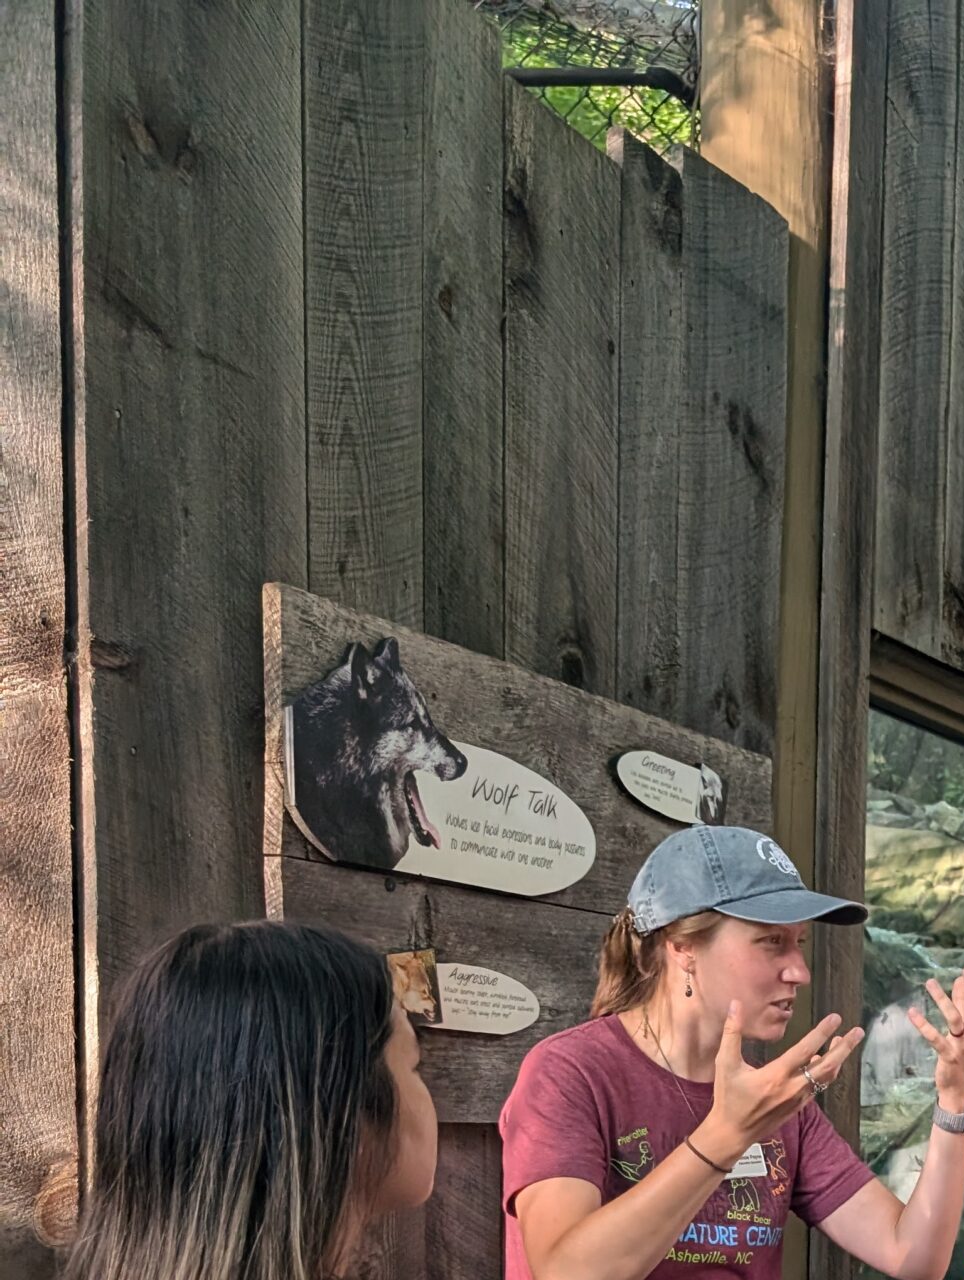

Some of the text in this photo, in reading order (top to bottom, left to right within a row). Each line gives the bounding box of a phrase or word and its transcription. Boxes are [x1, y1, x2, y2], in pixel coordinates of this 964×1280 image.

[641, 755, 676, 780] Greeting
[472, 776, 558, 820] Wolf Talk
[445, 813, 468, 831] Wolves
[501, 828, 532, 846] expressions
[460, 840, 498, 859] communicate
[448, 967, 499, 987] Aggressive
[727, 1210, 751, 1222] black
[753, 1214, 772, 1226] bear
[746, 1225, 782, 1247] CENT
[734, 1251, 754, 1265] NC
